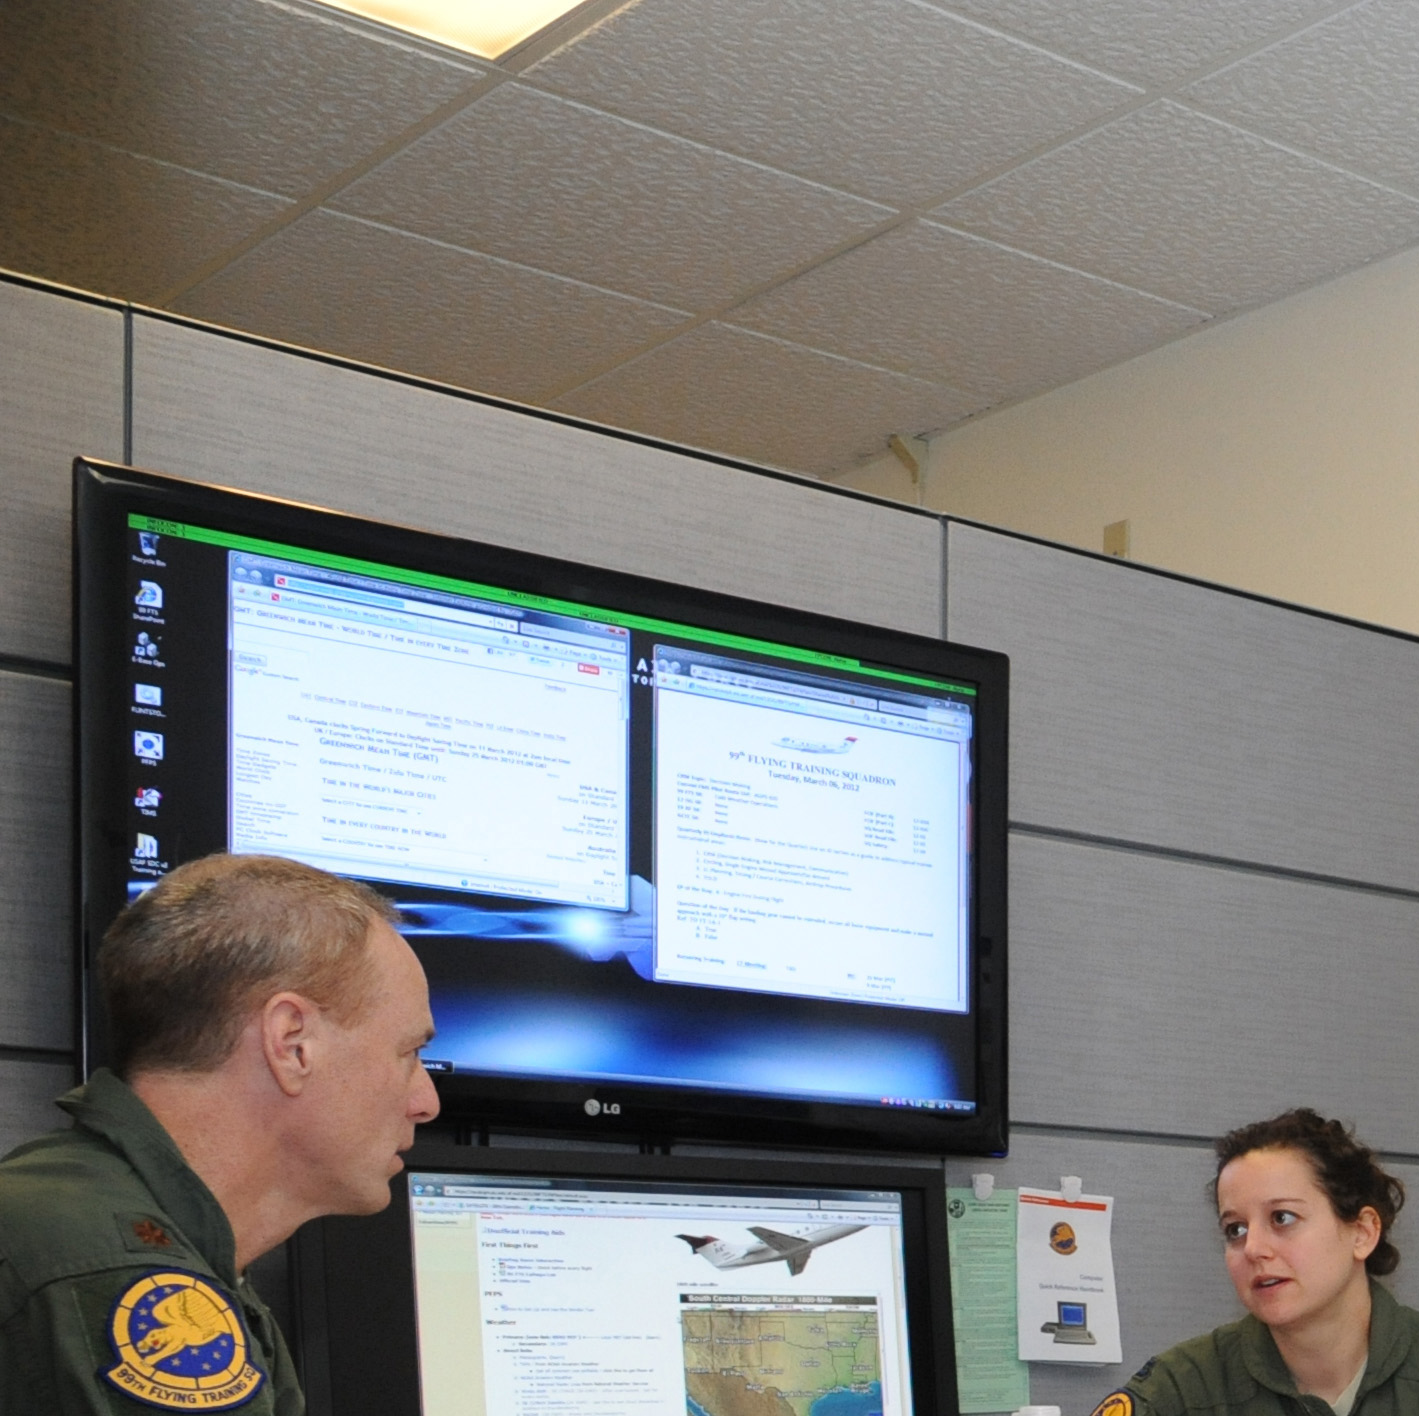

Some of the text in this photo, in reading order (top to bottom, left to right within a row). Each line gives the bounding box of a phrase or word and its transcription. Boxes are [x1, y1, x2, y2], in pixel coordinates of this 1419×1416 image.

[603, 1103, 620, 1114] LG
[116, 1368, 145, 1392] 99TH
[149, 1386, 197, 1404] FLYING
[202, 1381, 248, 1403] TRAINING
